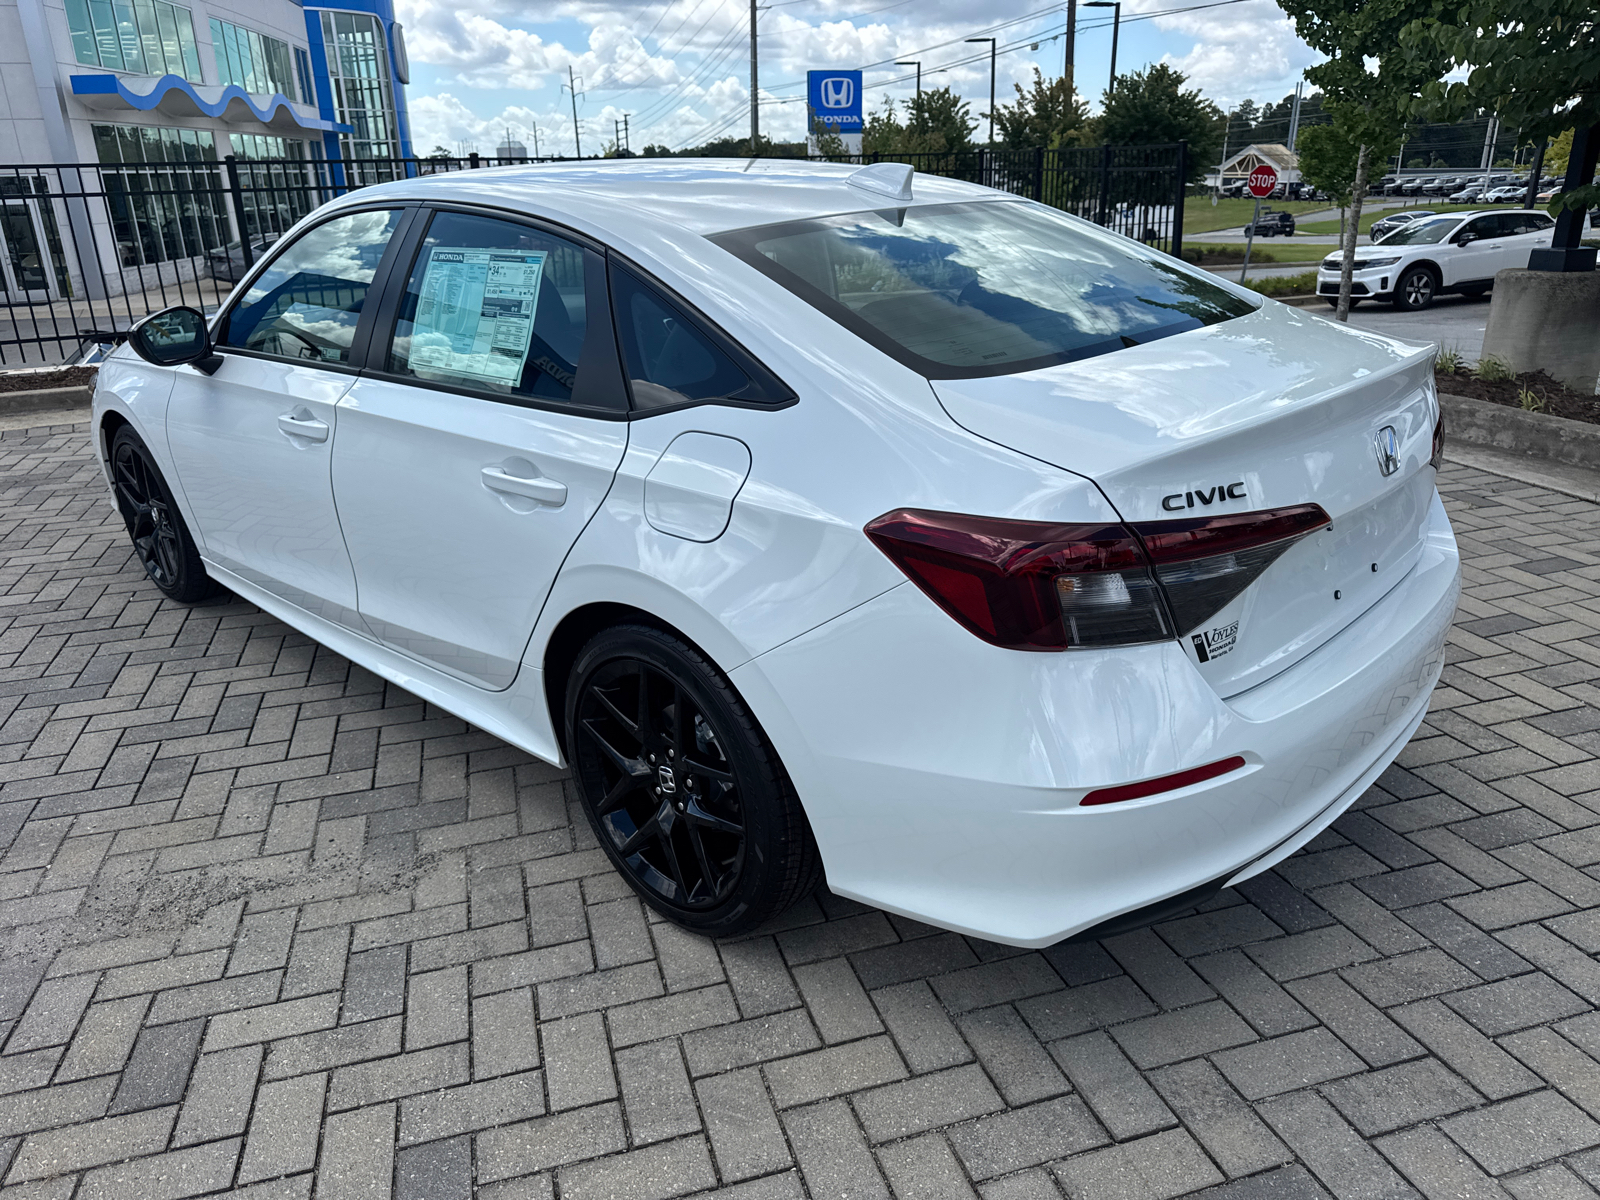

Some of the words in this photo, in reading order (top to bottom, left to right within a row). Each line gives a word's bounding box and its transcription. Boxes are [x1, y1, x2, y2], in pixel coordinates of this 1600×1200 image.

[1250, 174, 1275, 187] STOP
[438, 253, 464, 261] HONDA
[491, 265, 500, 275] 34
[1161, 481, 1247, 511] CIVIC
[1203, 623, 1239, 648] VOYLES
[1209, 641, 1232, 654] HONDA
